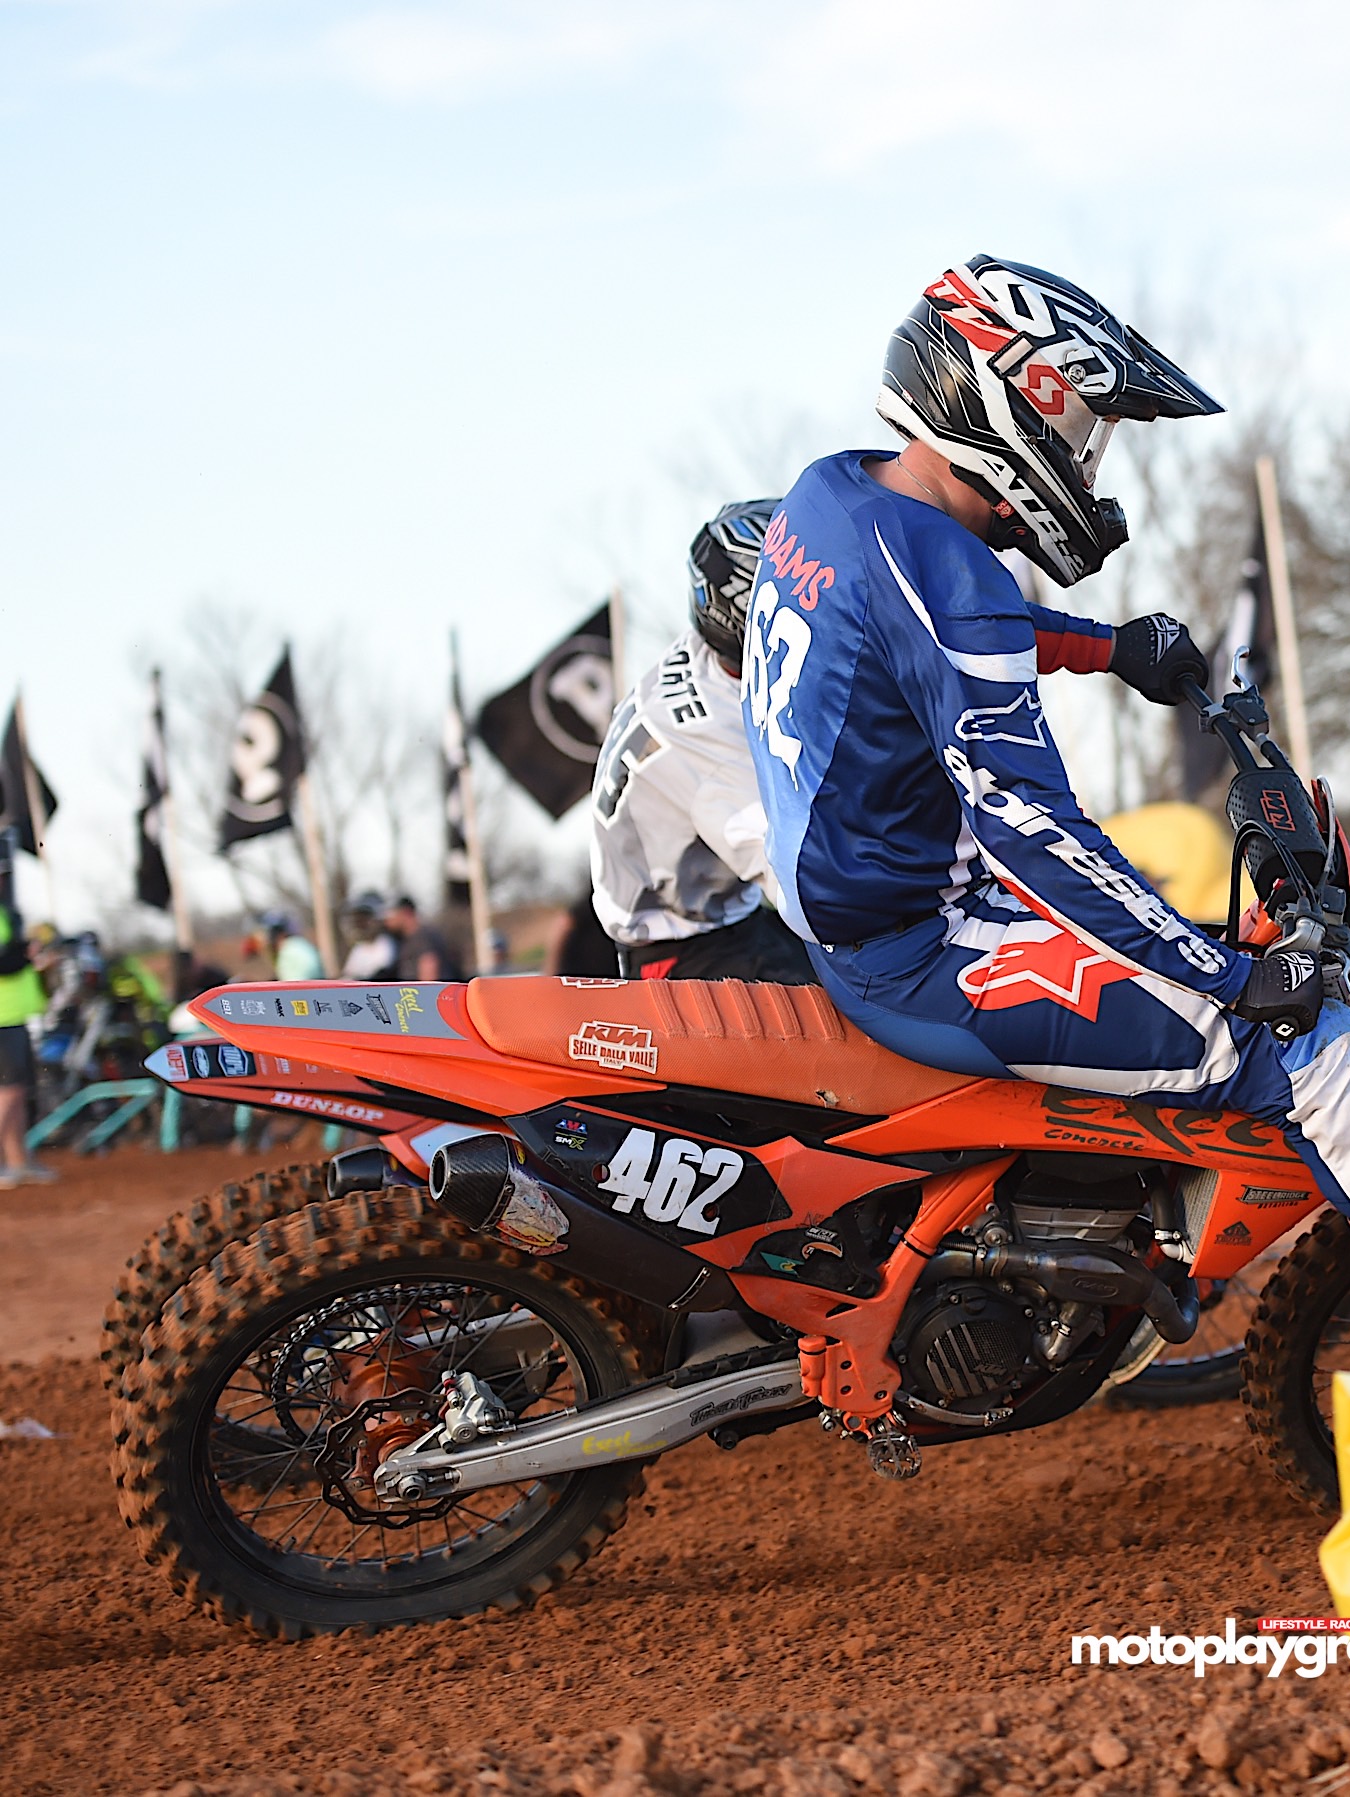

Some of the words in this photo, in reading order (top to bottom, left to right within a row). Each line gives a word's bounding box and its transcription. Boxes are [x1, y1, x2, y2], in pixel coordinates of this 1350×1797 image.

[983, 454, 1085, 584] ATR-2
[763, 509, 835, 611] ADAMS
[741, 559, 813, 792] 62
[1260, 789, 1297, 832] KTM
[944, 744, 1228, 974] alpinestars
[573, 1039, 597, 1056] SELLE
[600, 1046, 626, 1061] DALLA
[629, 1050, 654, 1068] VALLE
[582, 1025, 649, 1049] KTM
[271, 1091, 384, 1122] DUNLOP
[555, 1135, 588, 1151] SMX
[1044, 1128, 1147, 1151] Concrete
[598, 1127, 744, 1235] 462
